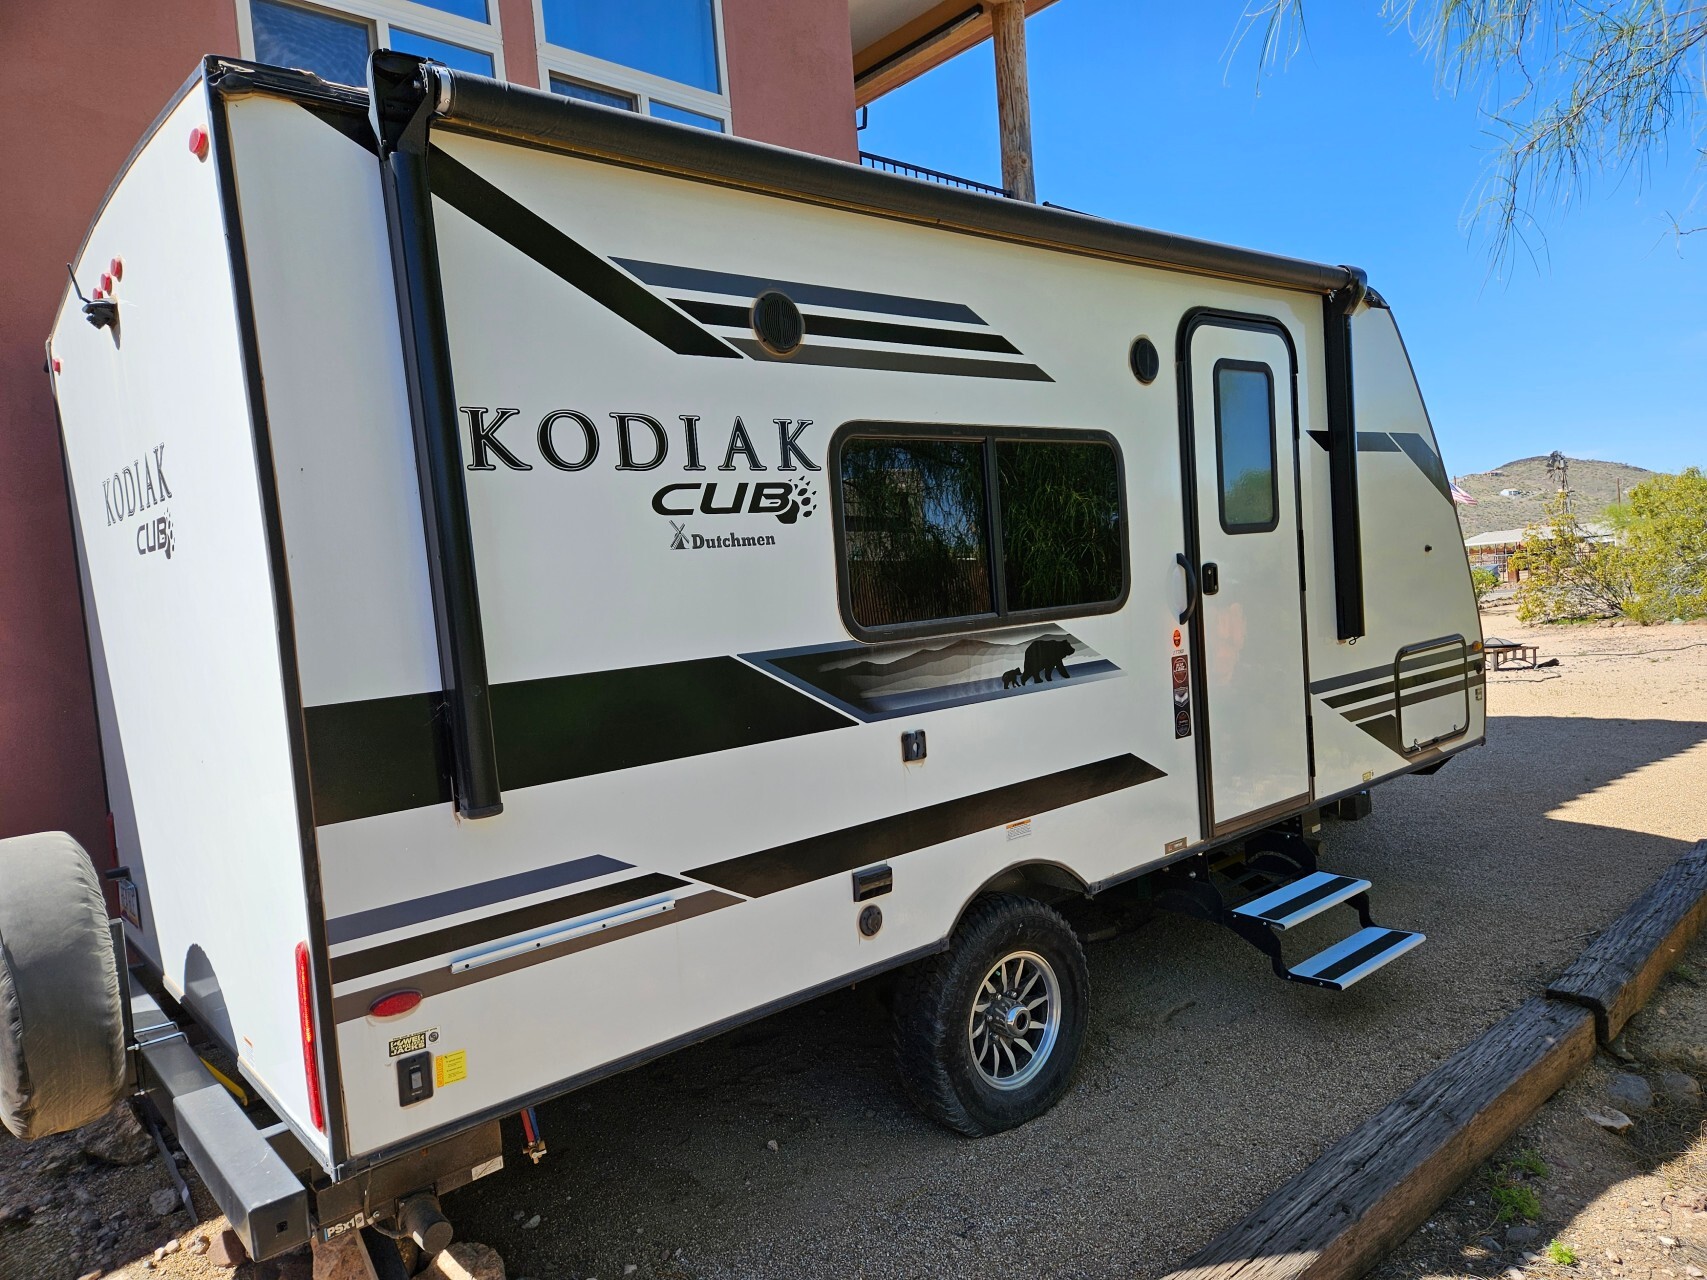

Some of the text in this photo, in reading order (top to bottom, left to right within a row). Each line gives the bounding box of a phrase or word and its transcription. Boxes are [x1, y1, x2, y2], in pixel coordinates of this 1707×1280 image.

[459, 406, 822, 472] KODIAK
[102, 442, 172, 526] KODIAK
[651, 482, 794, 516] CUB
[136, 516, 167, 555] CUB
[691, 532, 776, 550] Dutchmen
